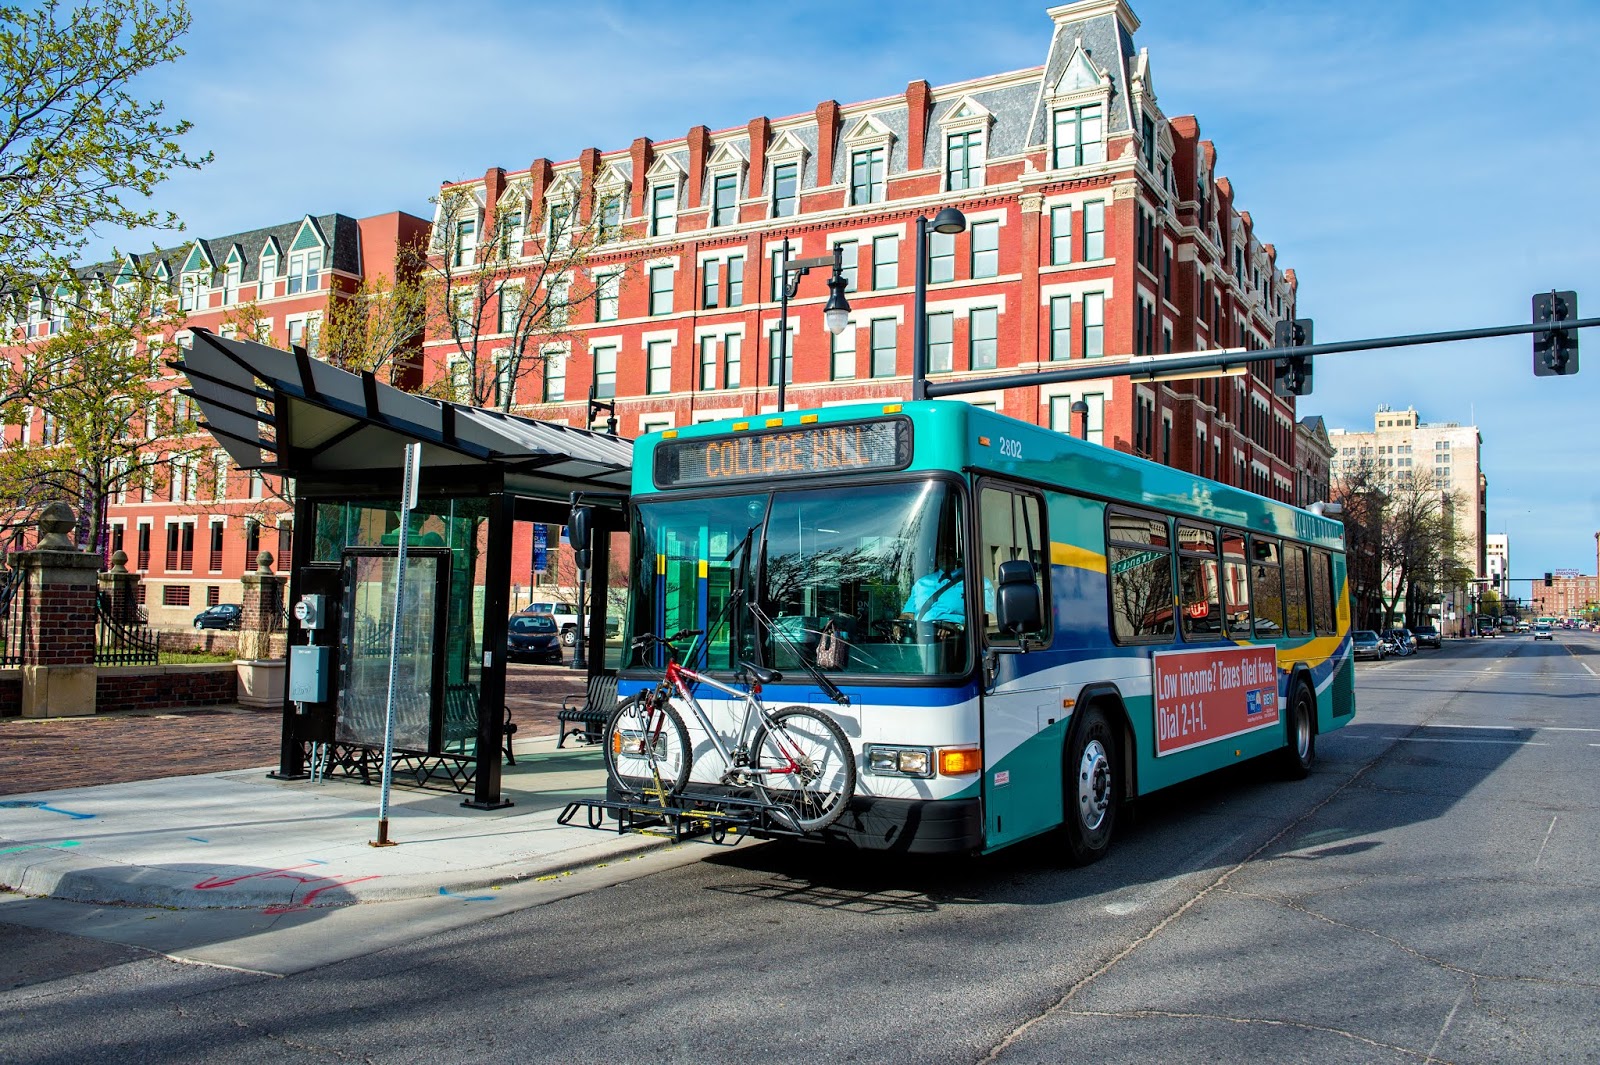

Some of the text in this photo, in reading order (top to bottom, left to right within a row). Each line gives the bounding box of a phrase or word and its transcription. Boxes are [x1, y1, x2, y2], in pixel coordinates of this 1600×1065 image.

[706, 427, 870, 478] COLLEGE HILL
[999, 436, 1023, 460] 2802
[1158, 657, 1275, 701] Low income? Taxes filed free.
[1159, 700, 1207, 741] Dial 2-1-1.
